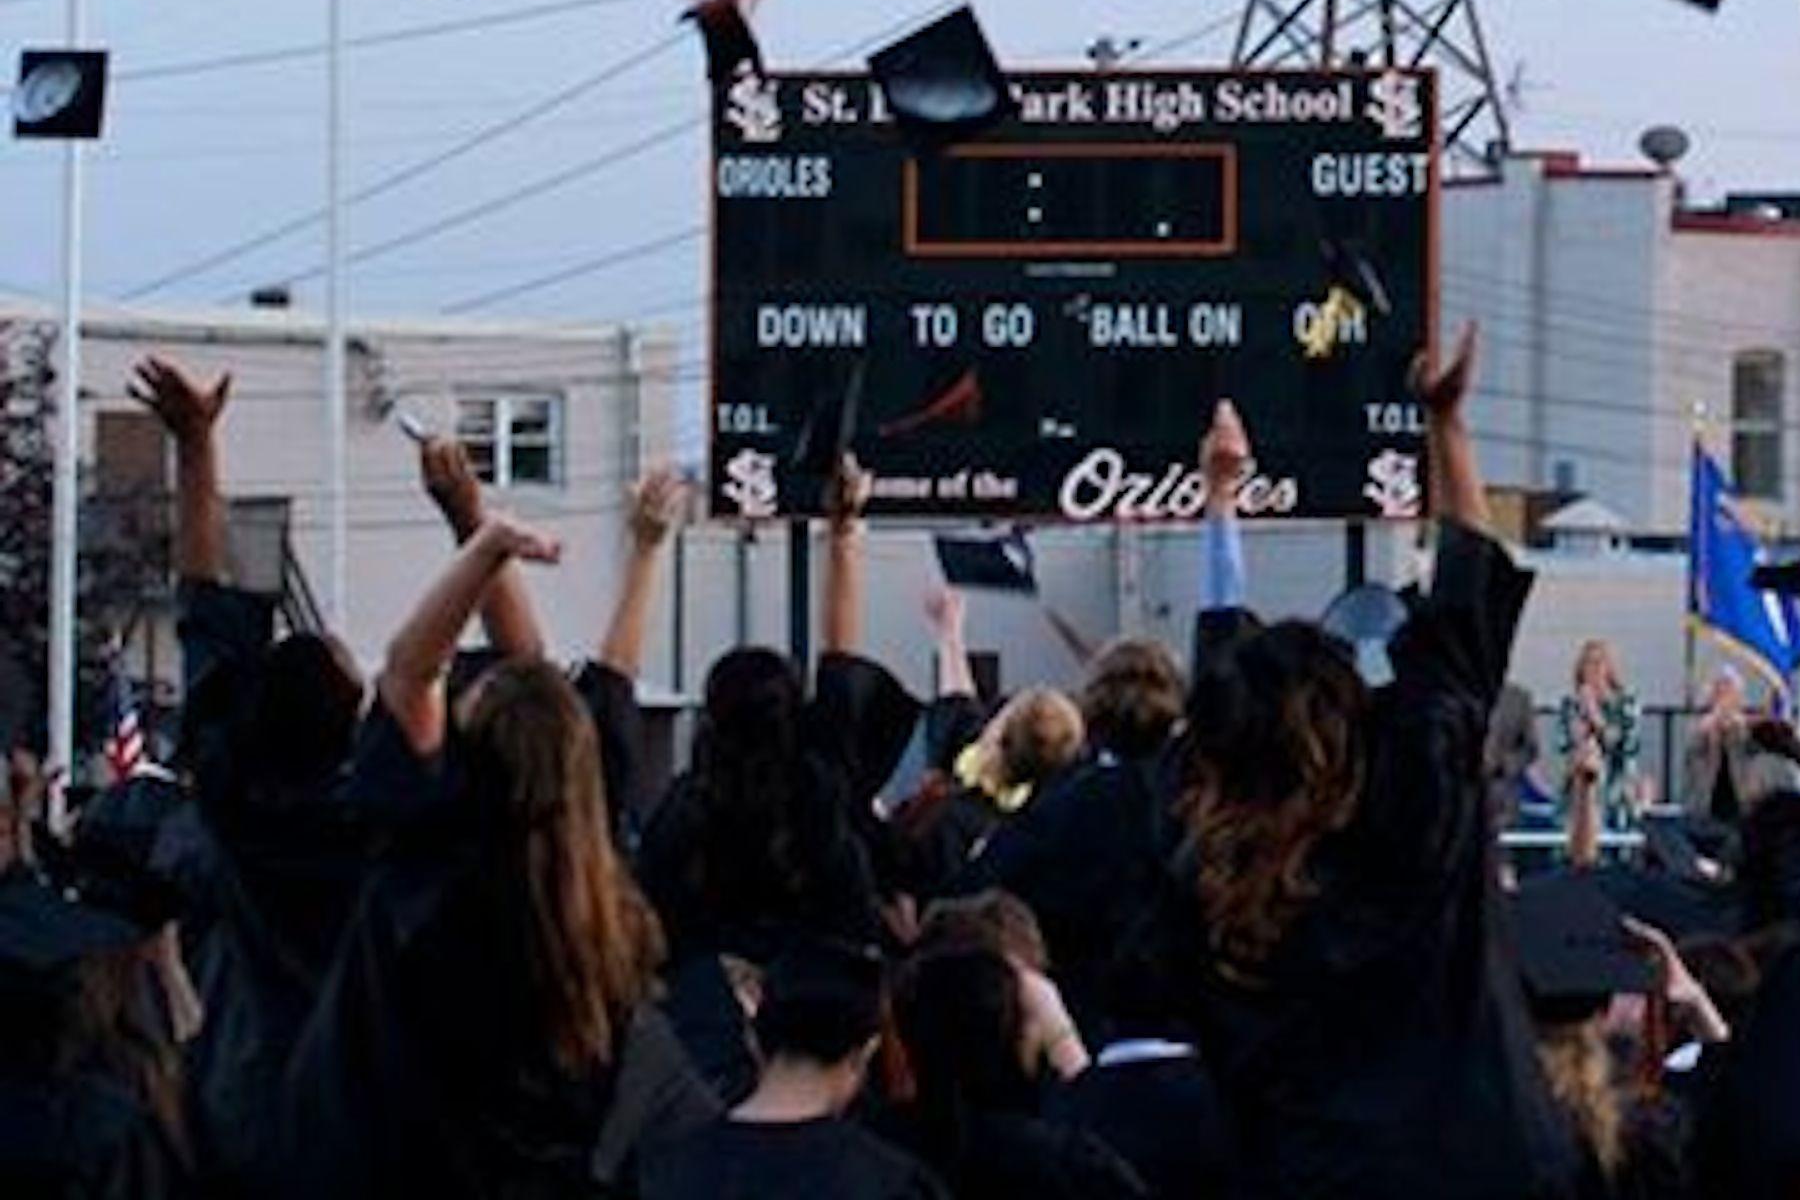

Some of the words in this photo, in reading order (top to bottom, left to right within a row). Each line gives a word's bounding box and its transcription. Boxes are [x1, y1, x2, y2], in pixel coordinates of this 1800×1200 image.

[802, 82, 858, 123] St.
[1104, 81, 1205, 131] High
[1214, 80, 1353, 123] School
[718, 155, 832, 198] ORIOLES
[1311, 152, 1430, 197] GUEST
[756, 303, 867, 347] DOWN
[910, 303, 958, 347] TO
[981, 303, 1035, 347] GO
[1090, 303, 1178, 347] BALL
[1188, 303, 1243, 347] ON
[1058, 446, 1299, 519] Orioes
